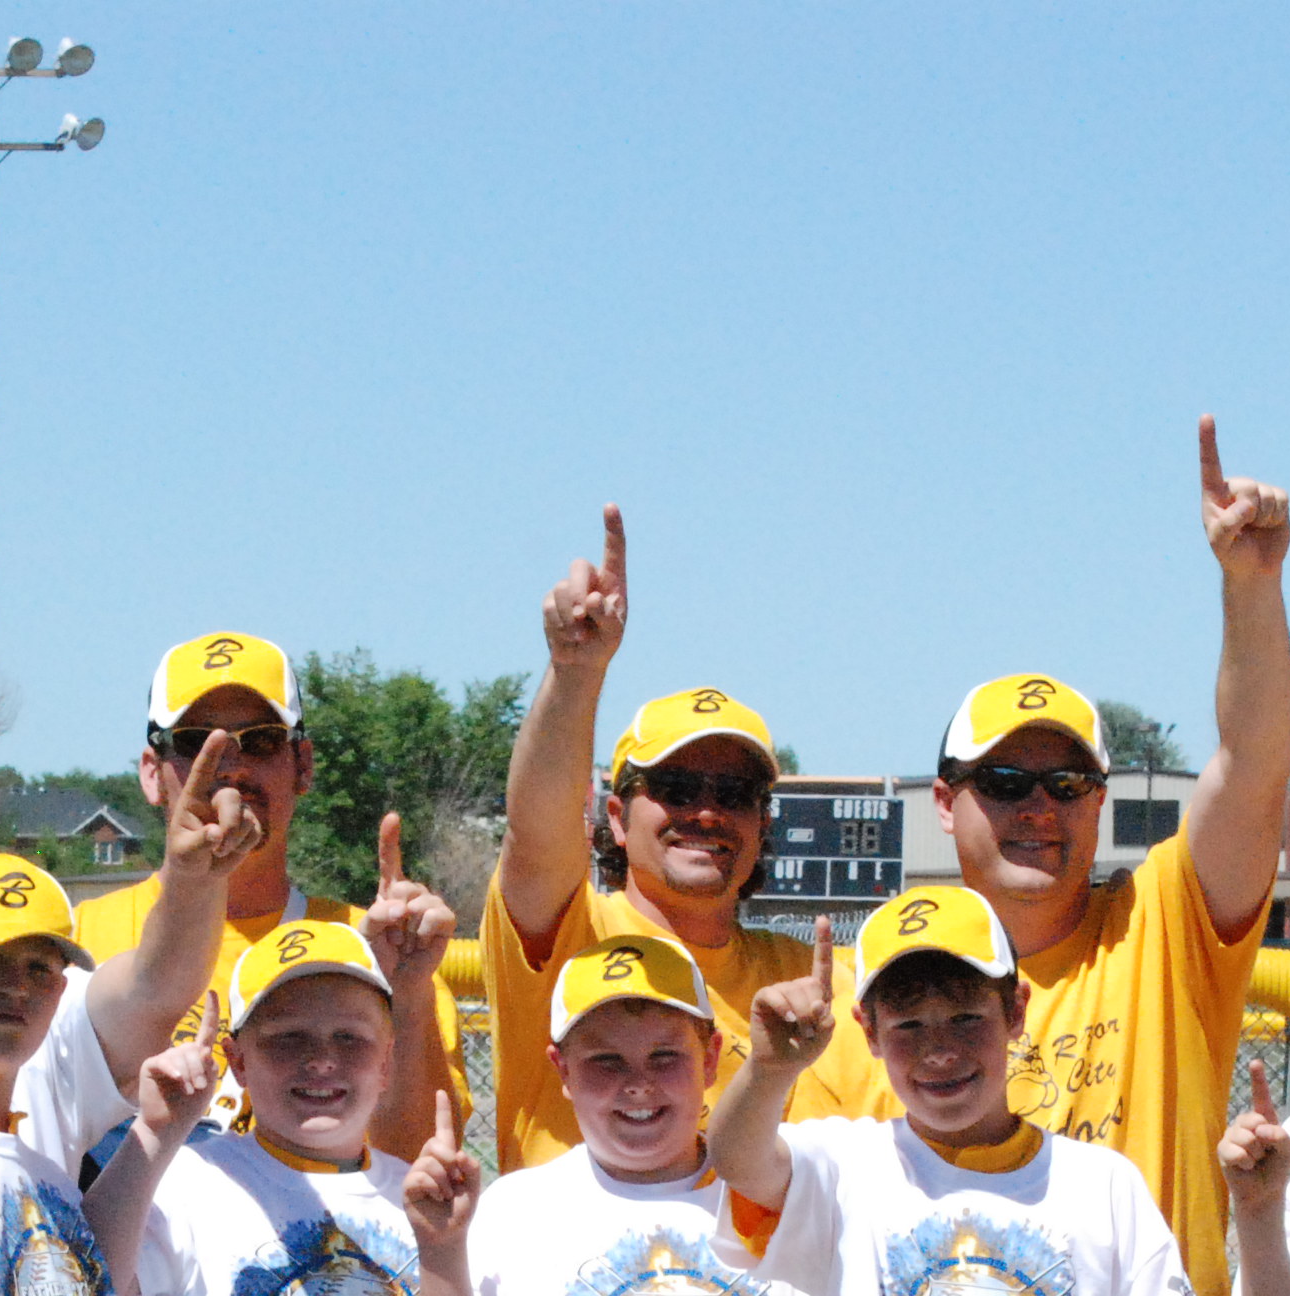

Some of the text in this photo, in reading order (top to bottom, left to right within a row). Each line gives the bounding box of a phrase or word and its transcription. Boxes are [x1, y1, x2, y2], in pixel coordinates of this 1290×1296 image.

[205, 637, 243, 669] B
[692, 689, 727, 713] B
[1018, 679, 1056, 710] B
[833, 799, 889, 820] GUESTS
[898, 900, 939, 935] B
[276, 929, 315, 964] B
[602, 945, 644, 981] B
[1052, 1018, 1120, 1066] Rzor
